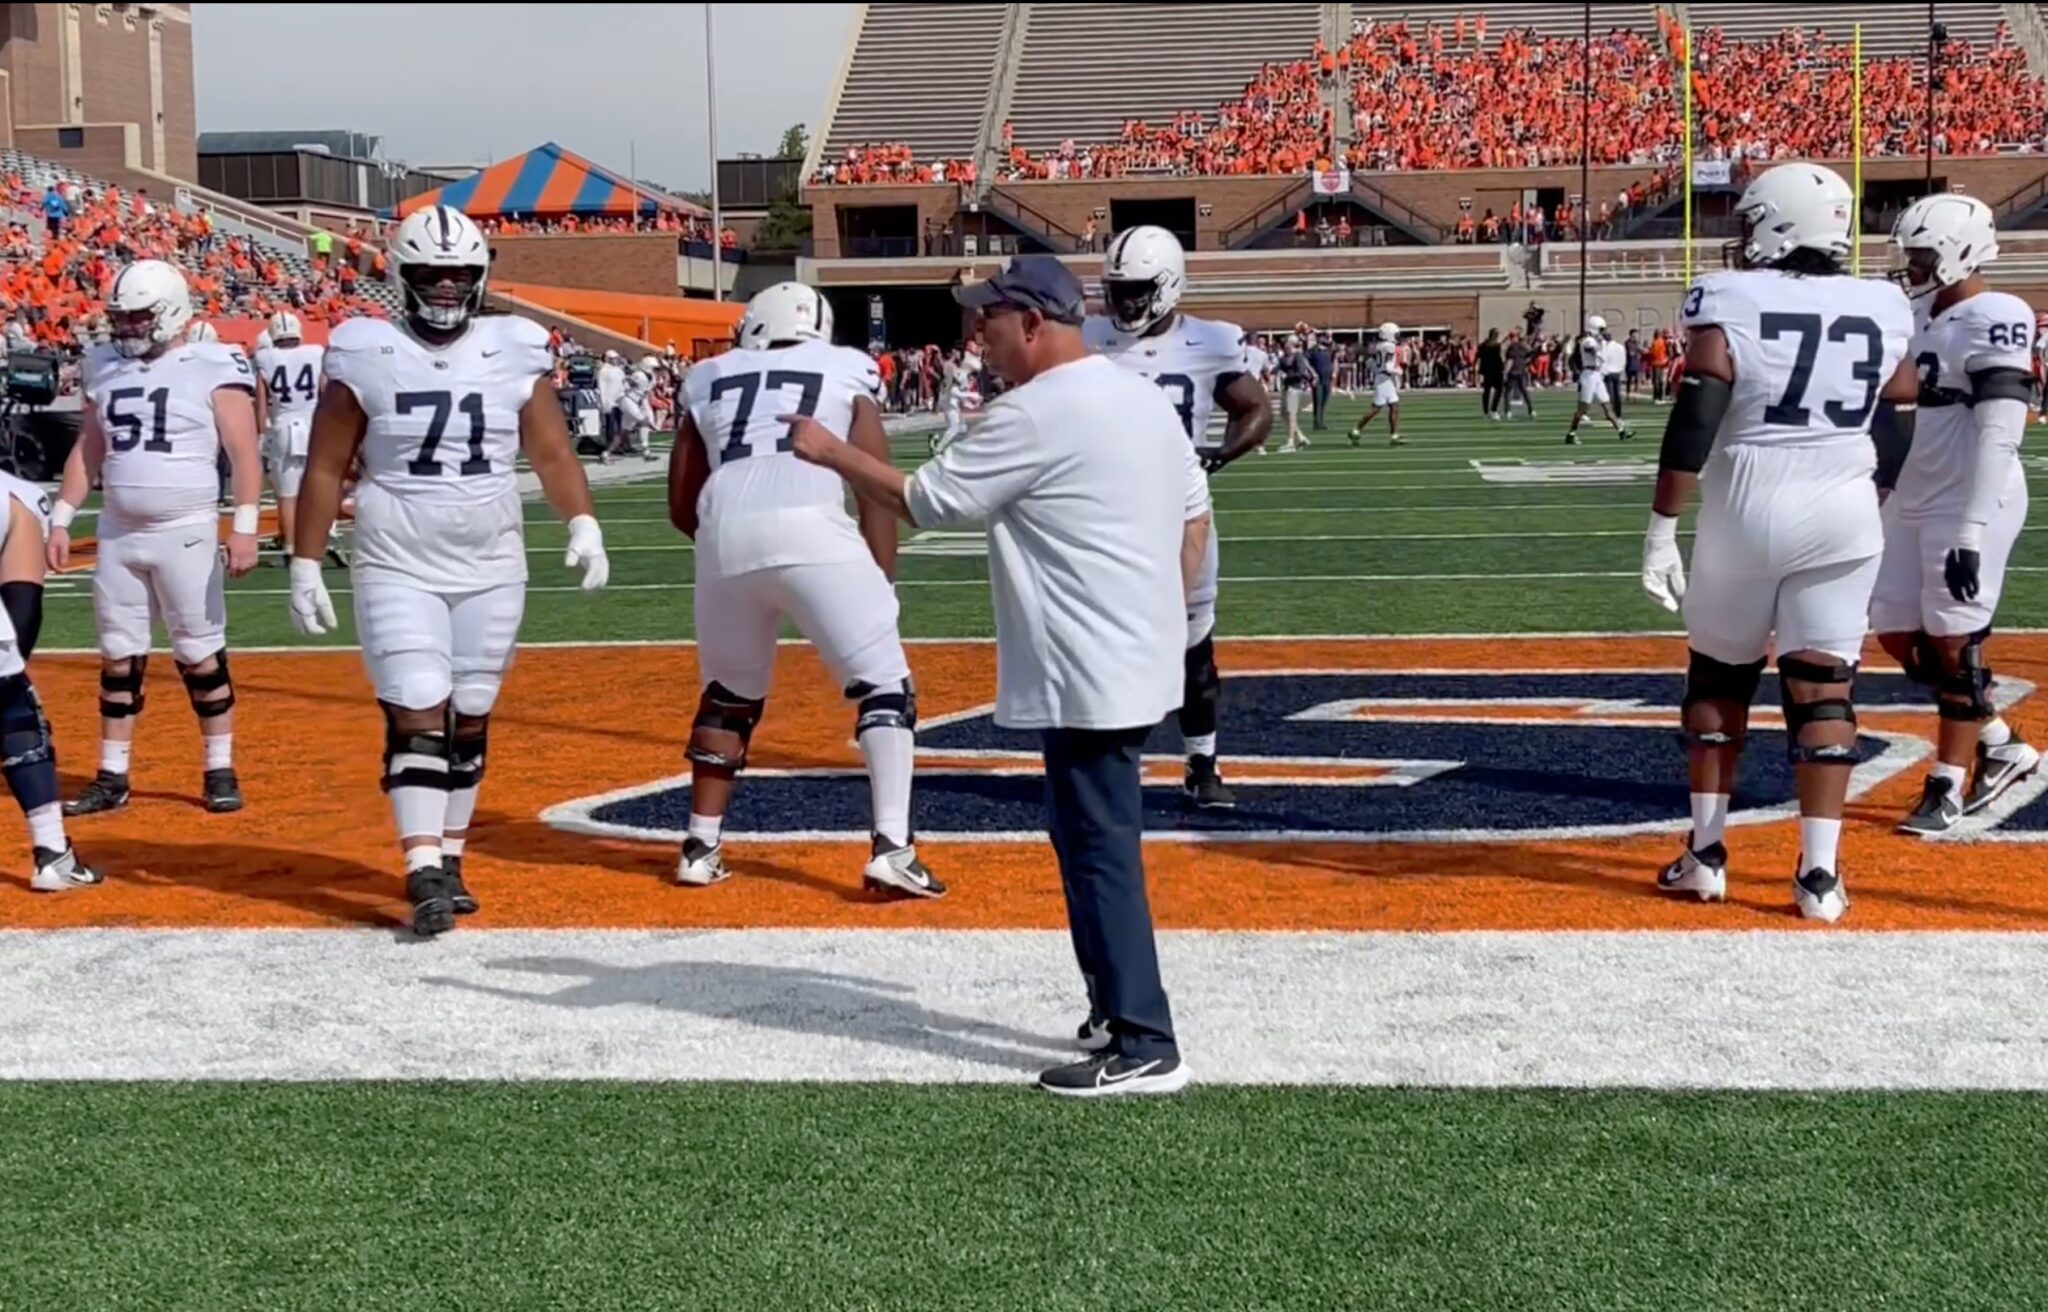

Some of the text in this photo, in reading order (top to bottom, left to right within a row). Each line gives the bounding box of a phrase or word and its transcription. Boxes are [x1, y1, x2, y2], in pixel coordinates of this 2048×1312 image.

[1684, 286, 1704, 318] 3
[1989, 323, 2028, 348] 66
[229, 352, 249, 374] 5
[270, 363, 316, 403] 44
[1760, 312, 1884, 428] 73
[107, 387, 172, 453] 51
[395, 390, 491, 476] 71
[710, 370, 824, 465] 77
